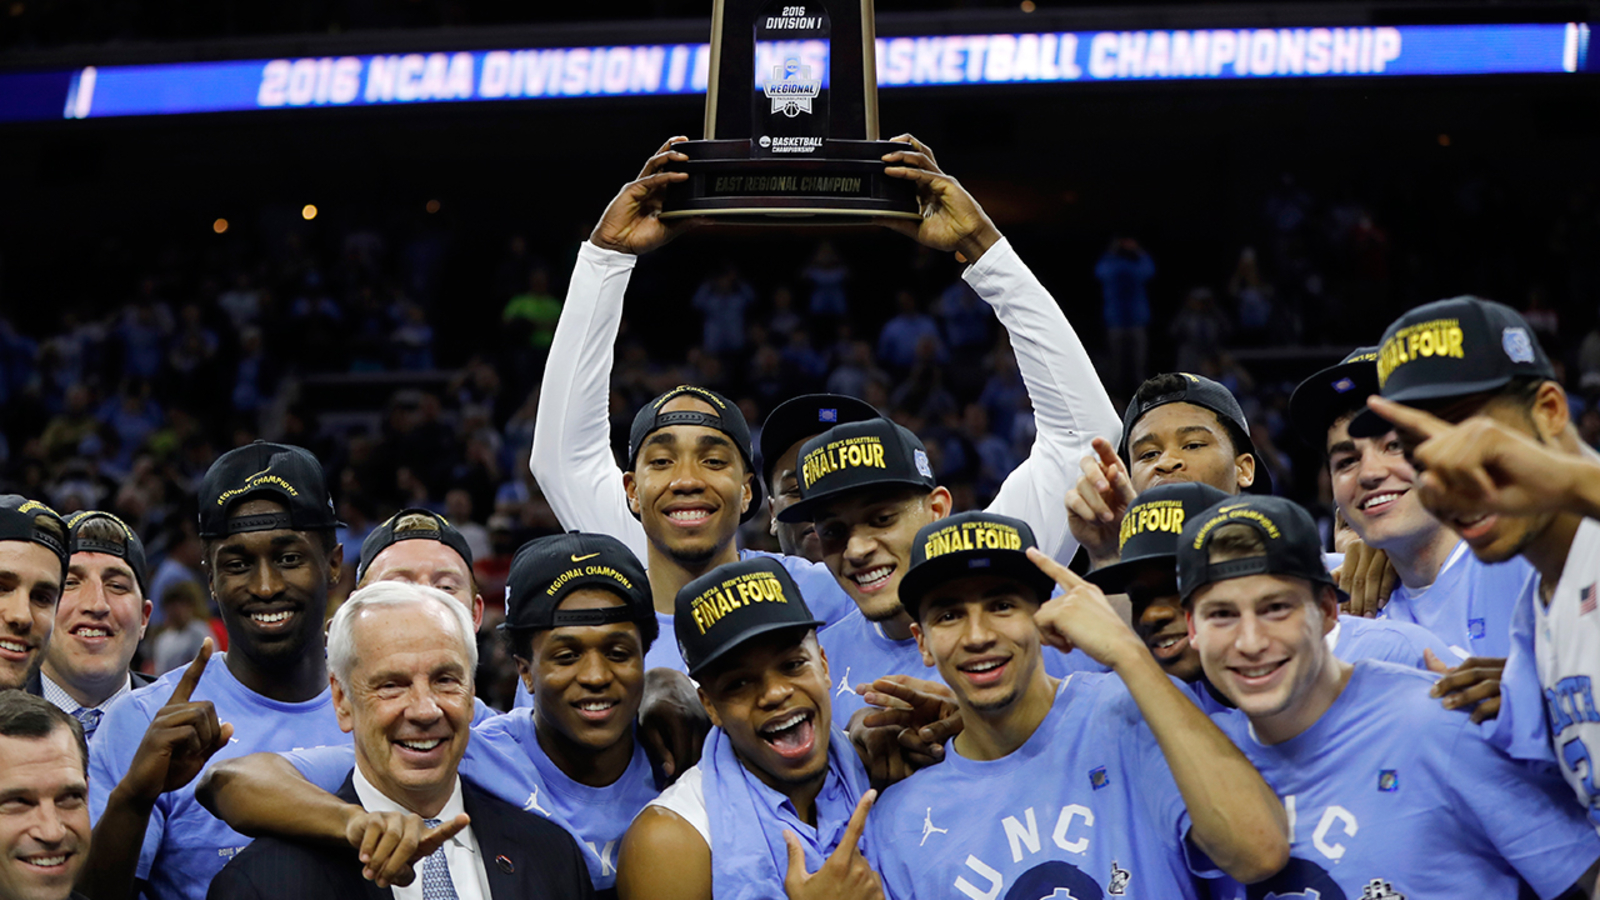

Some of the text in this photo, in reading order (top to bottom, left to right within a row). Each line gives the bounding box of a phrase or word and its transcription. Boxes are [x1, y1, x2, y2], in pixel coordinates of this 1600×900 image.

[765, 17, 815, 29] DIVISION
[782, 6, 805, 16] 2016
[257, 59, 362, 107] 2016
[364, 51, 474, 102] NCAA
[478, 46, 664, 98] DIVISION
[666, 44, 690, 92] I
[876, 33, 1082, 85] SKETBALL
[1088, 26, 1402, 79] CHAMPIONSHIP
[770, 84, 814, 94] REGIONAL
[772, 137, 822, 146] BASKETBALL
[715, 176, 861, 193] EAST REGIONAL CHAMPION
[1408, 327, 1464, 360] FOUR
[845, 436, 881, 446] BASKETBALL
[802, 443, 886, 490] FINAL FOUR
[253, 475, 299, 497] CHAMPIONS
[1138, 507, 1185, 535] FOUR
[924, 528, 1022, 560] FINAL FOUR
[546, 566, 633, 597] REGIONAL CHAMPIONS
[721, 576, 742, 590] MEN'S
[690, 577, 788, 635] FINAL FOUR
[953, 803, 1095, 900] UNC
